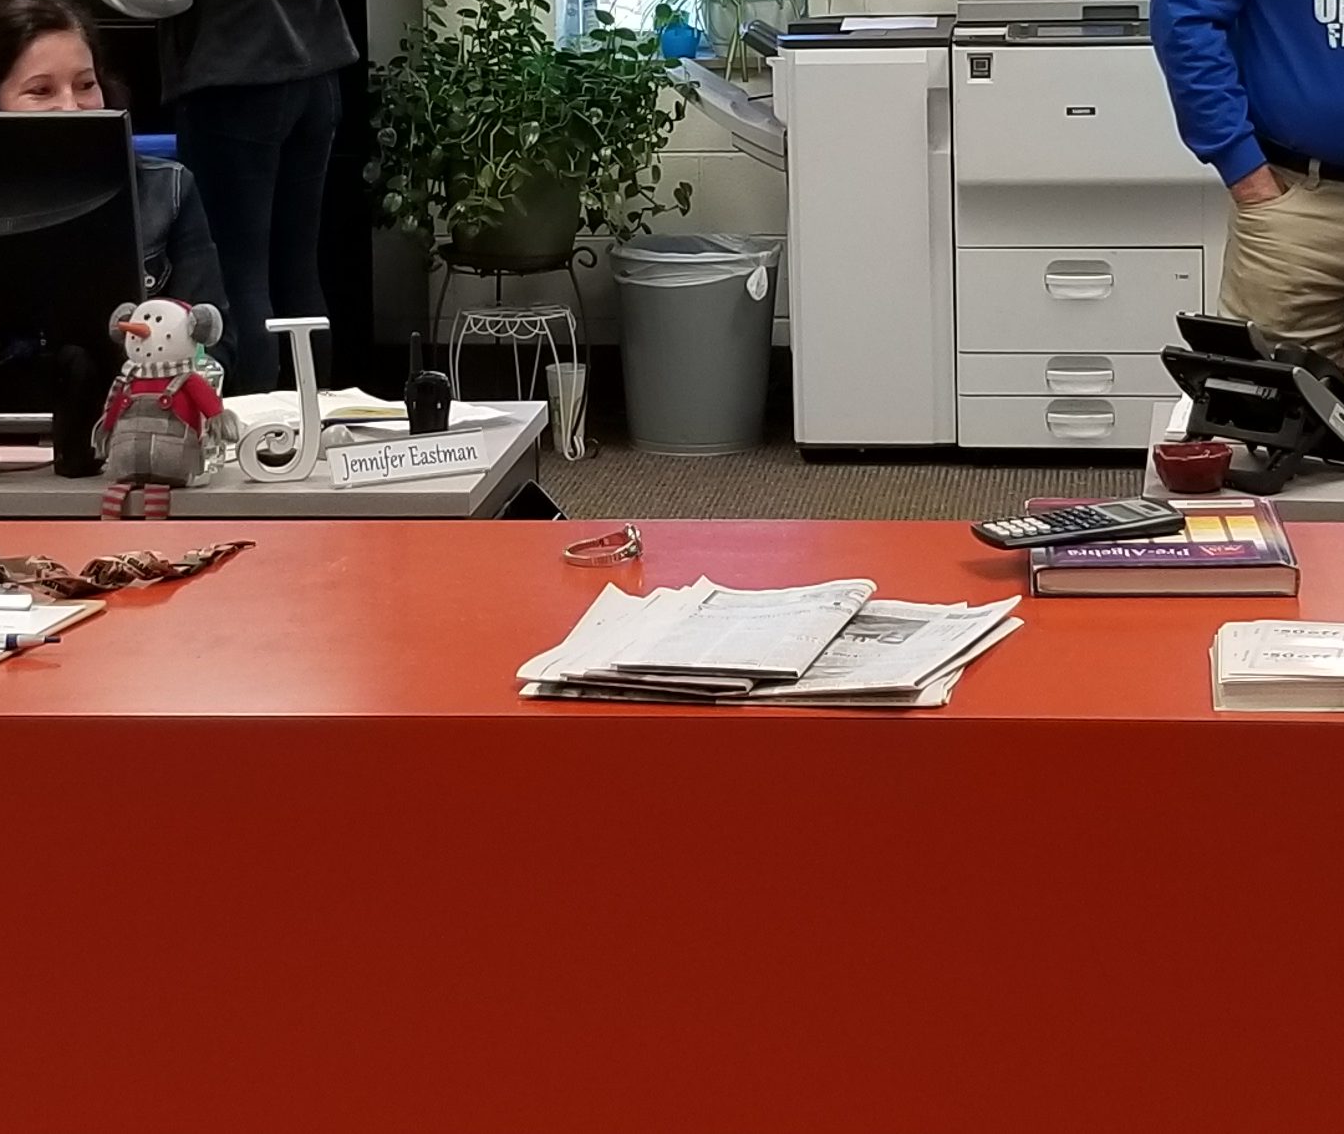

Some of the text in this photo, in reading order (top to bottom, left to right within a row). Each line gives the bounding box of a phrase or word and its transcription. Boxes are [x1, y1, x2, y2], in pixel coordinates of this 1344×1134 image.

[236, 316, 330, 482] J
[342, 444, 478, 481] Jennifer Eastman
[1067, 544, 1191, 559] Pre-Algebra
